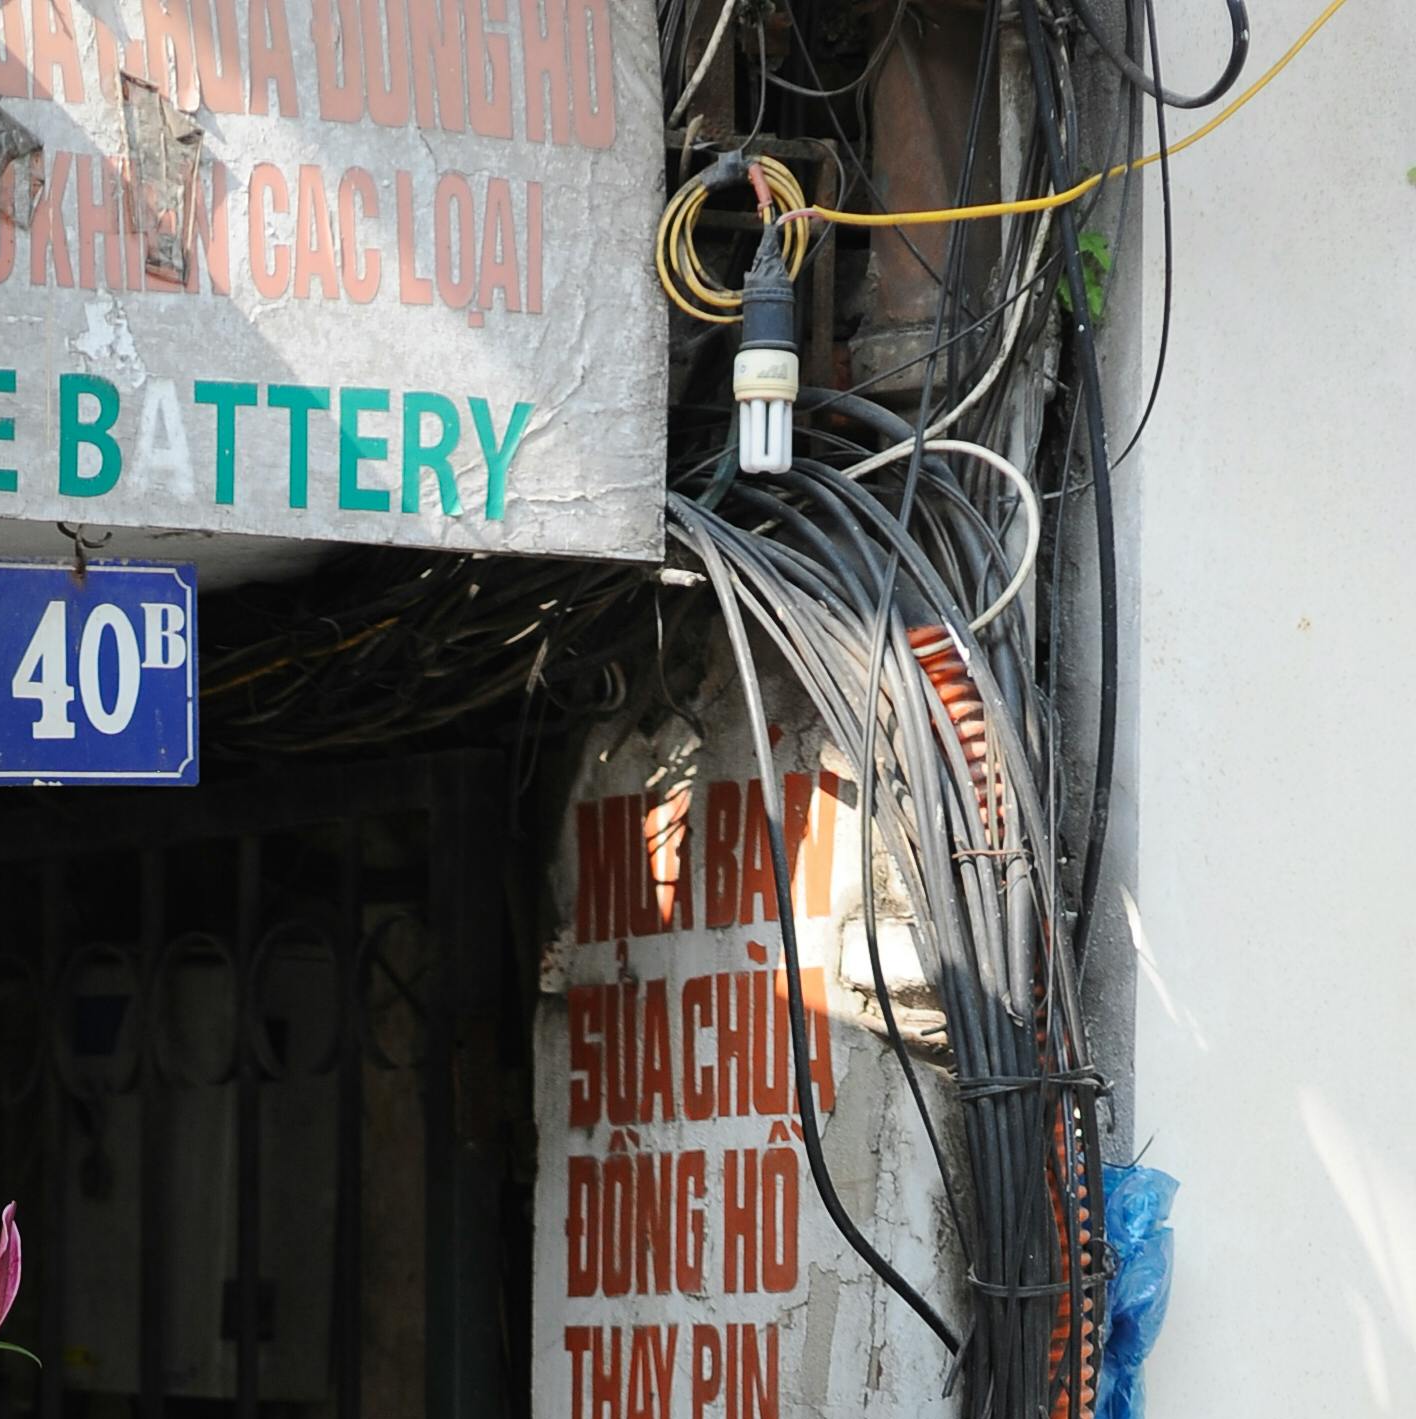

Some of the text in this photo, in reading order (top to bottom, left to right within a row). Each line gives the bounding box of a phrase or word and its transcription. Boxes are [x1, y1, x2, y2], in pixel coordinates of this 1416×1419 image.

[58, 372, 537, 522] BATTERY
[11, 600, 187, 740] 40B
[575, 789, 694, 945] MUA
[564, 1118, 804, 1299] ĐỒNG HỒ
